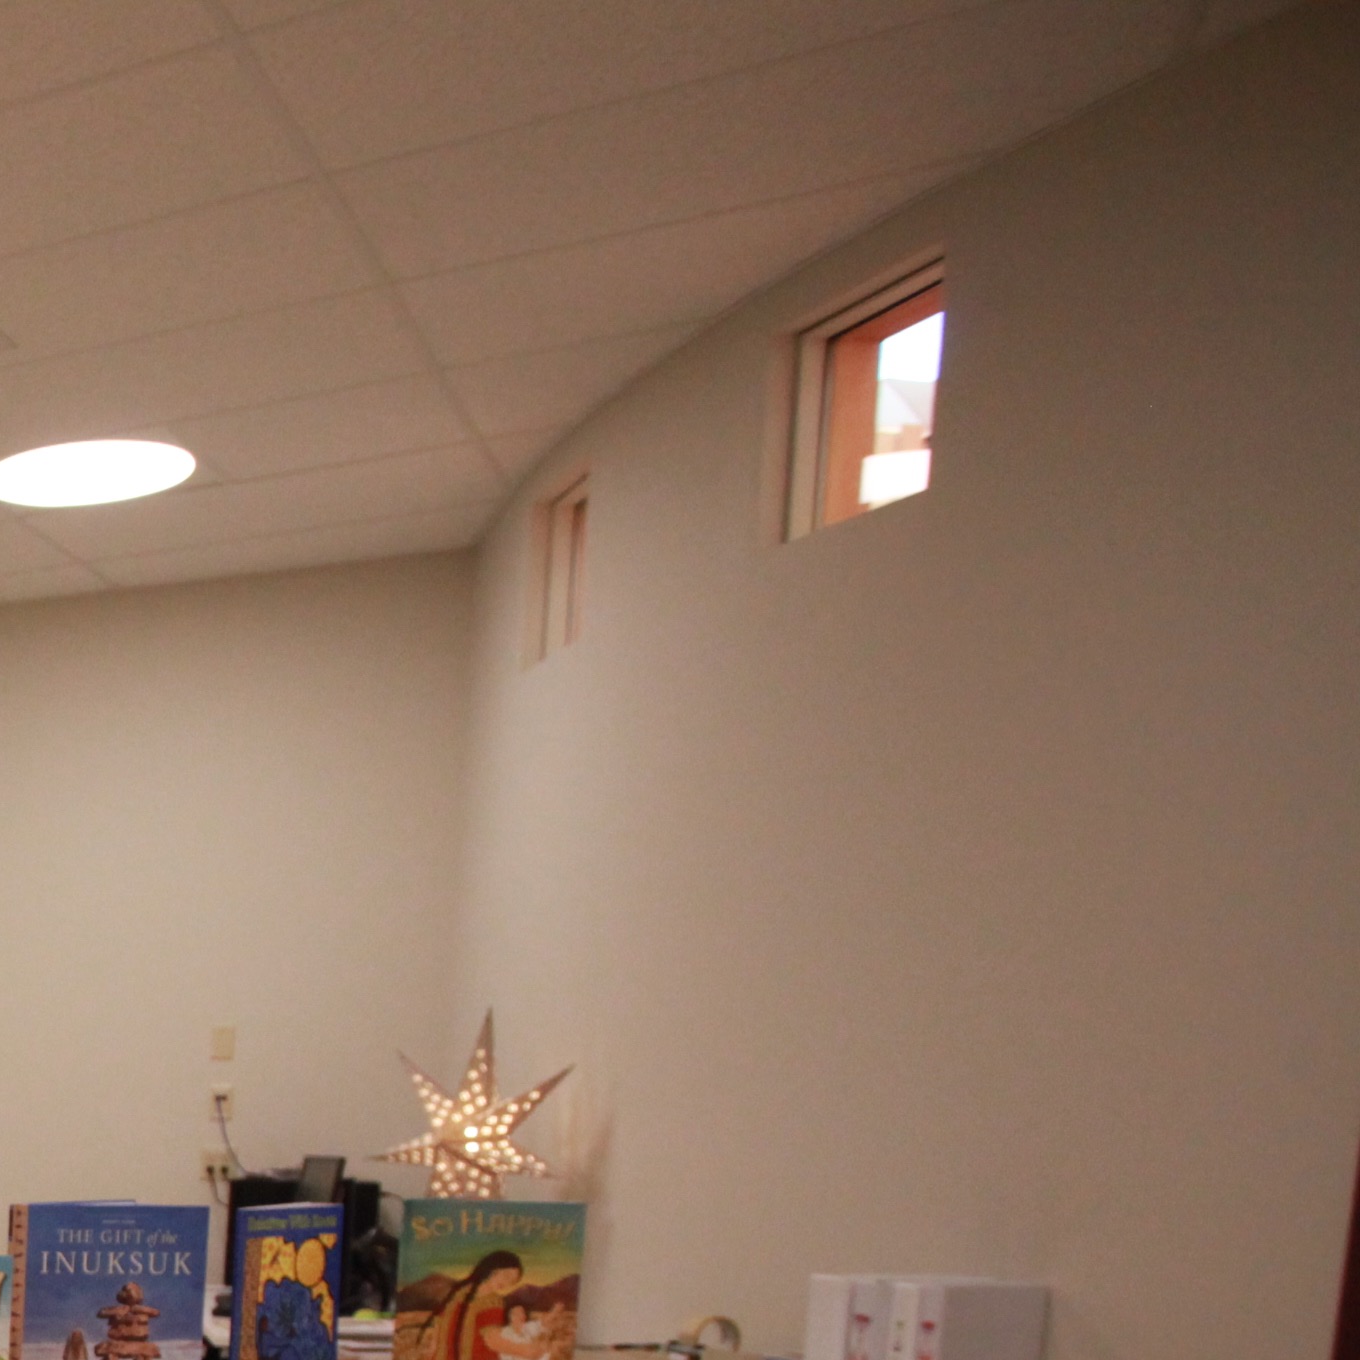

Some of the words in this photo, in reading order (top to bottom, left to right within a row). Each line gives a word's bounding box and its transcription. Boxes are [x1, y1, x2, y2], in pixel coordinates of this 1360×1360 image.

[58, 1228, 94, 1244] THE
[100, 1228, 145, 1244] GIFT
[146, 1227, 159, 1248] of
[160, 1227, 178, 1245] the
[40, 1251, 192, 1276] INUKSUK
